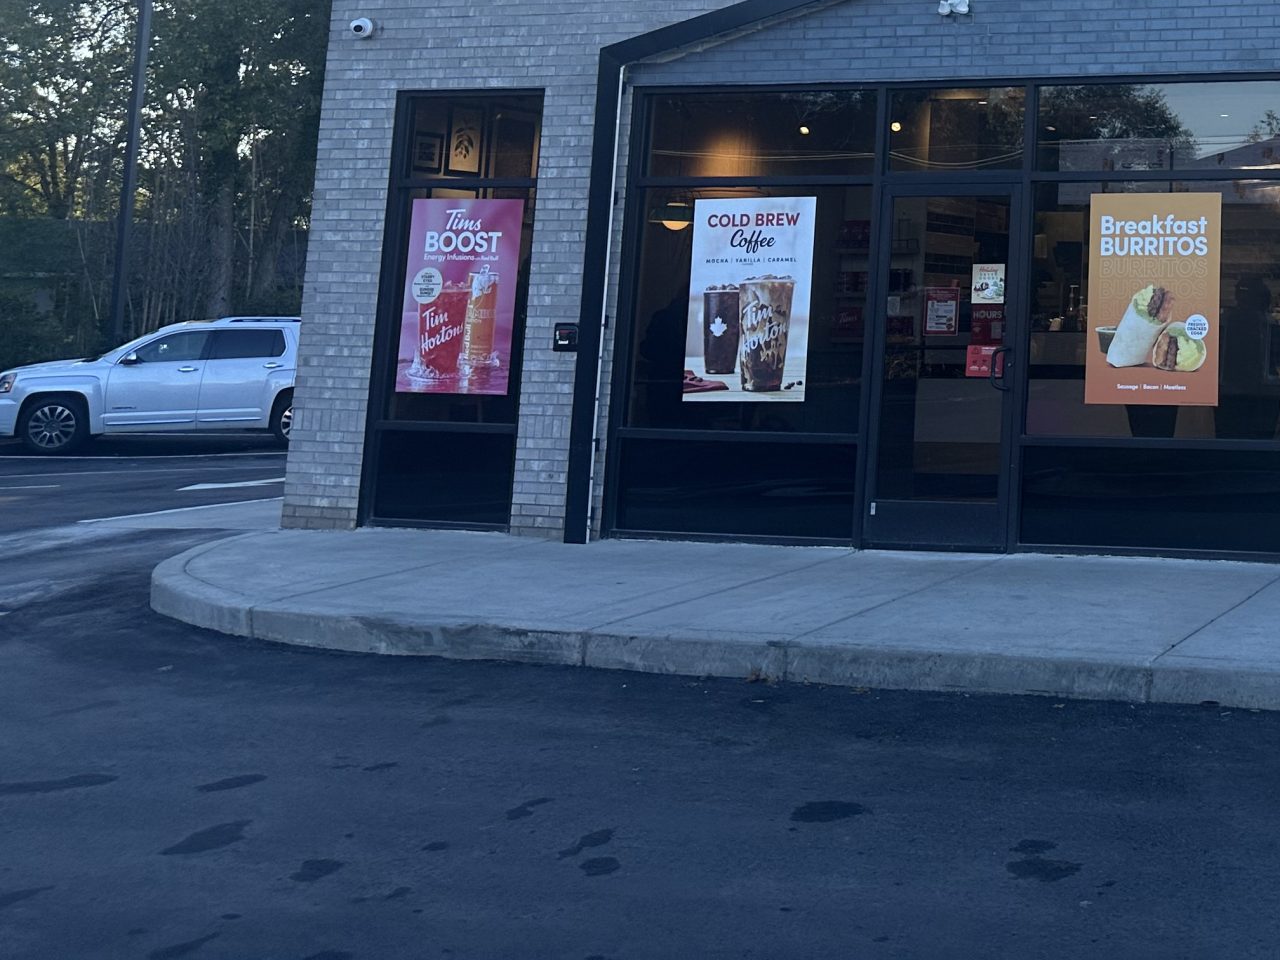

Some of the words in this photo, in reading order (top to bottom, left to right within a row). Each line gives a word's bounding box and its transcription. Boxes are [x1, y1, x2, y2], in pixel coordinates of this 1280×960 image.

[446, 209, 482, 231] Tims
[707, 214, 751, 228] COLD
[755, 212, 800, 227] BREW
[1101, 214, 1208, 234] Breakfast
[425, 231, 502, 252] BOOST
[730, 228, 776, 254] Coffee
[1100, 236, 1208, 256] BURRITOS
[424, 254, 446, 262] Energy
[447, 253, 475, 261] Infusions
[1100, 257, 1208, 278] BURRITOS
[422, 306, 449, 331] Tim
[742, 300, 773, 329] Tim
[973, 311, 1003, 320] HOURS
[1117, 383, 1139, 391] Sausage
